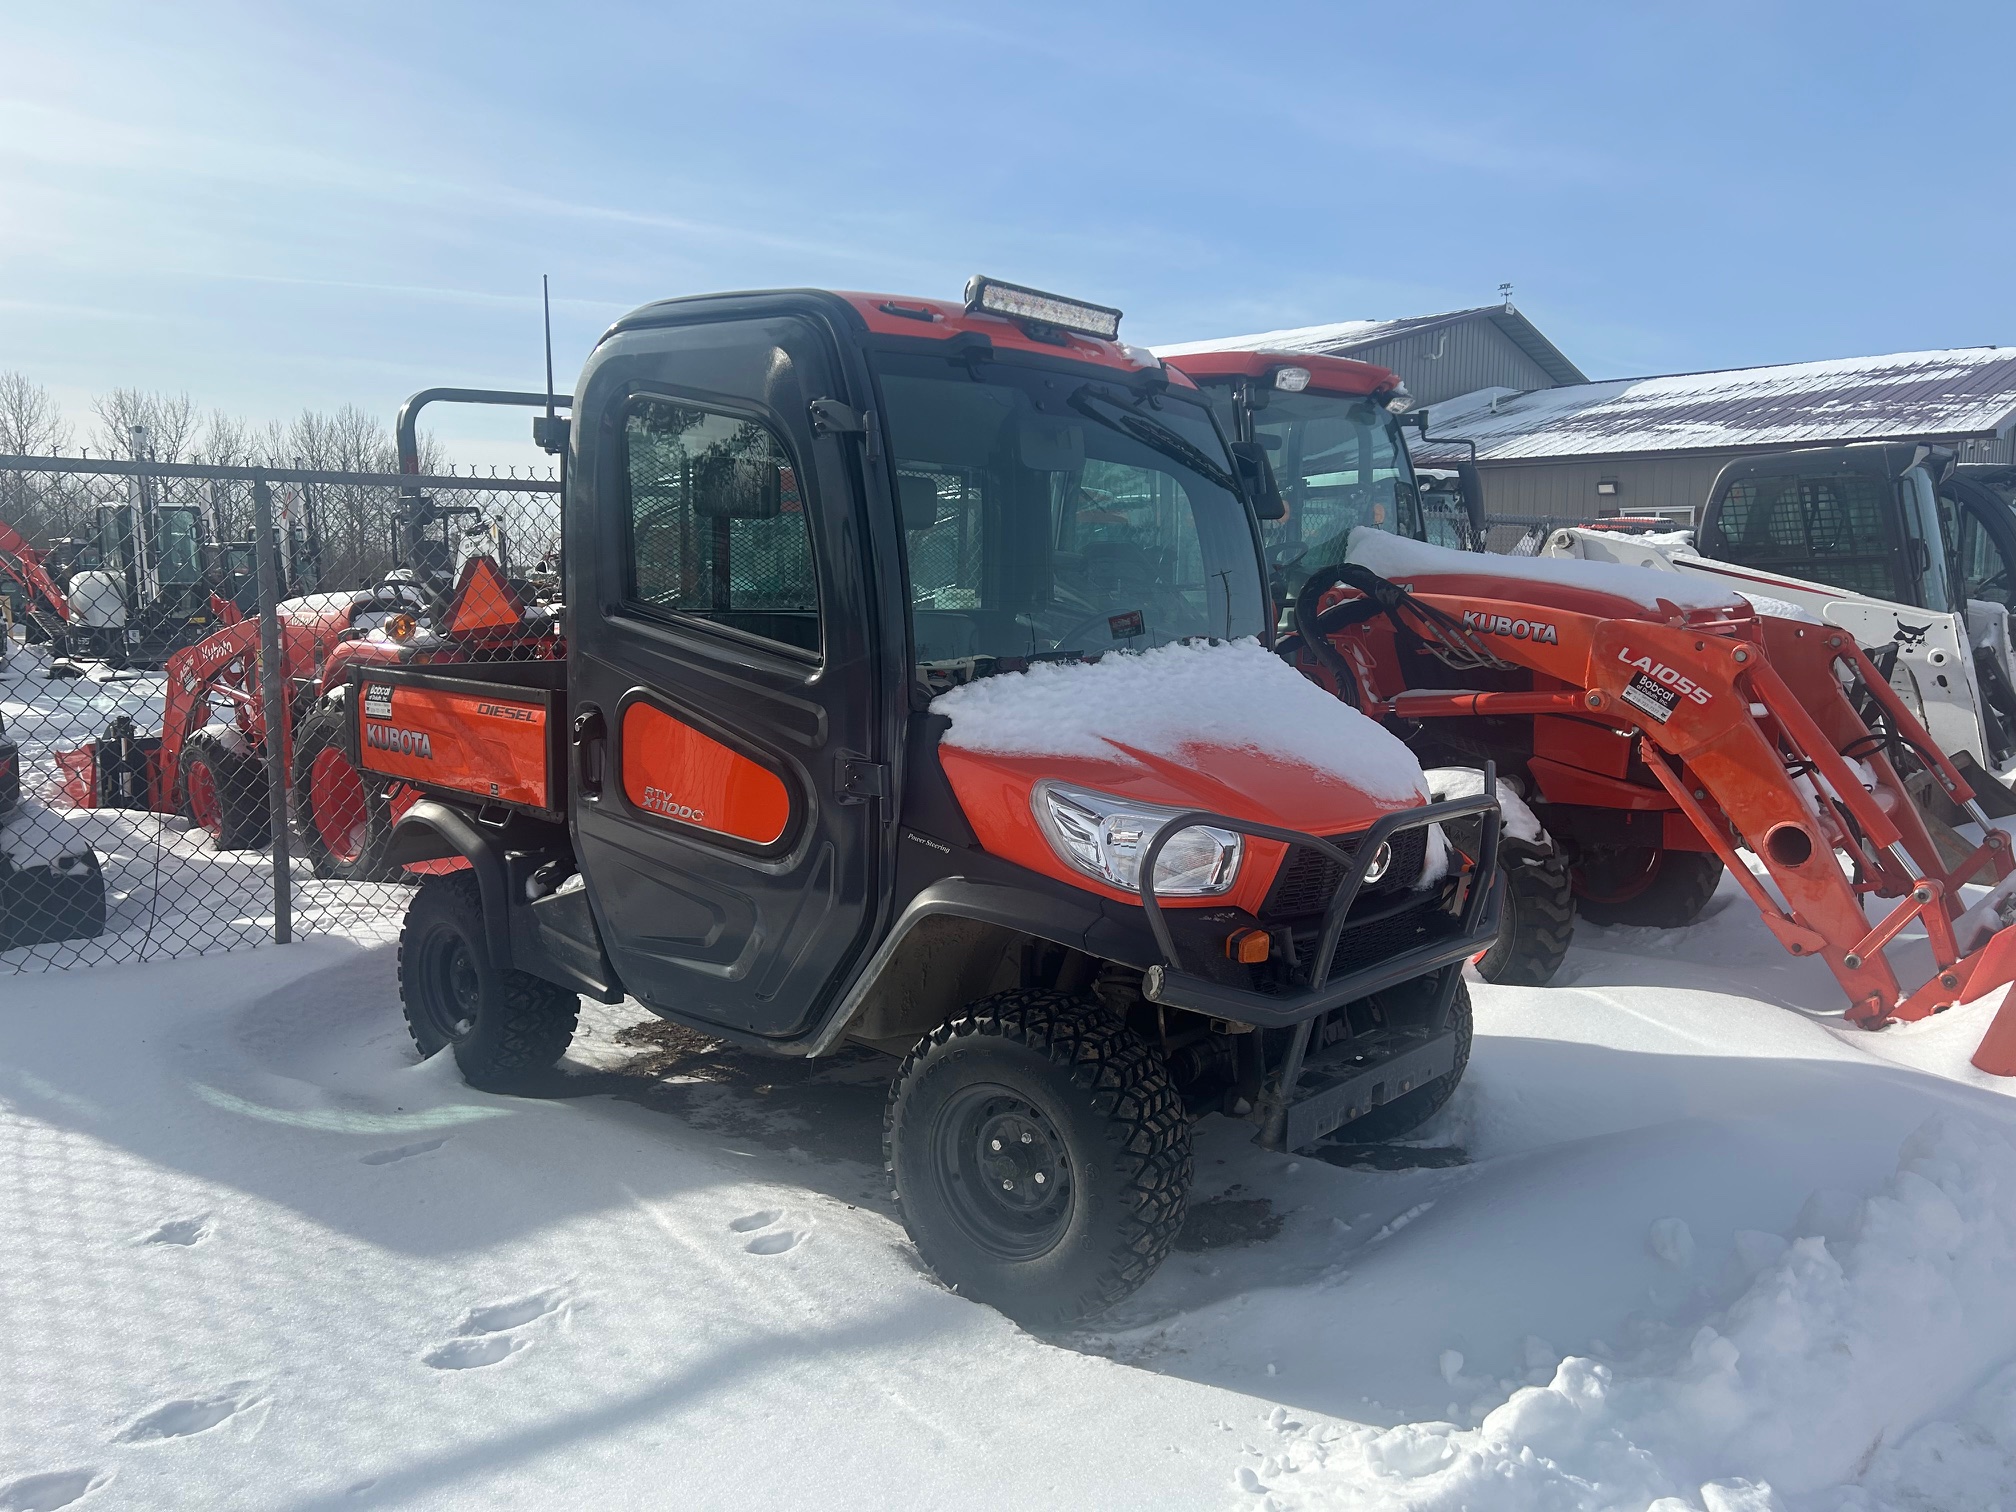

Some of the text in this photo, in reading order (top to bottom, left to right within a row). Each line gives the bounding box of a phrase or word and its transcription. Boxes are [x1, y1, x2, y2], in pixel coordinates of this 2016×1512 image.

[1462, 610, 1558, 645] KUBOTA
[201, 640, 233, 661] Kubota
[1618, 647, 1712, 705] LA1055
[1639, 675, 1674, 702] Bobcat
[477, 704, 537, 722] DIESEL
[366, 722, 433, 760] KUBOTA
[644, 786, 673, 801] RTV
[642, 796, 704, 822] X1100C
[908, 833, 951, 854] Power Steering
